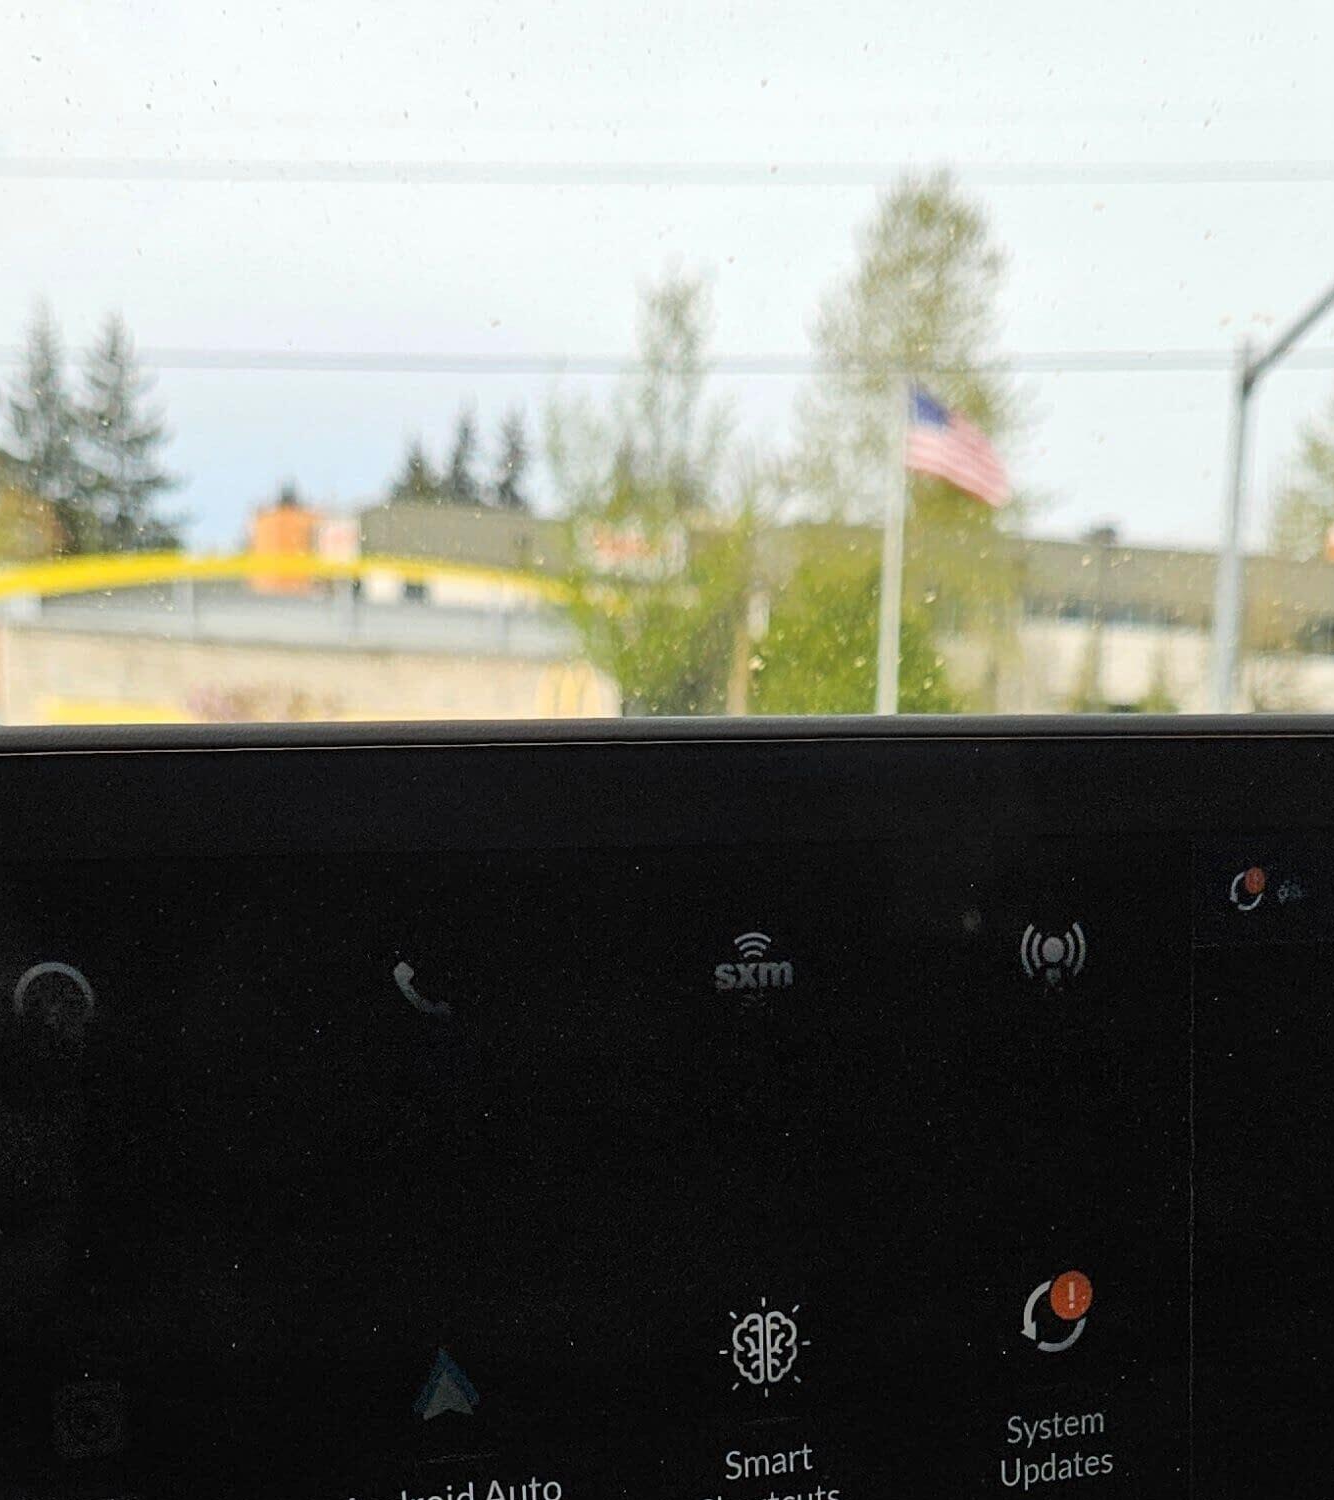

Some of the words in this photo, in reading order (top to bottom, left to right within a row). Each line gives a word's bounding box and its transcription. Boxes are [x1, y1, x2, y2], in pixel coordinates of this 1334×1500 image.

[714, 957, 794, 991] sxm
[1006, 1409, 1105, 1448] System
[724, 1443, 813, 1480] Smart
[1000, 1450, 1114, 1490] Updates
